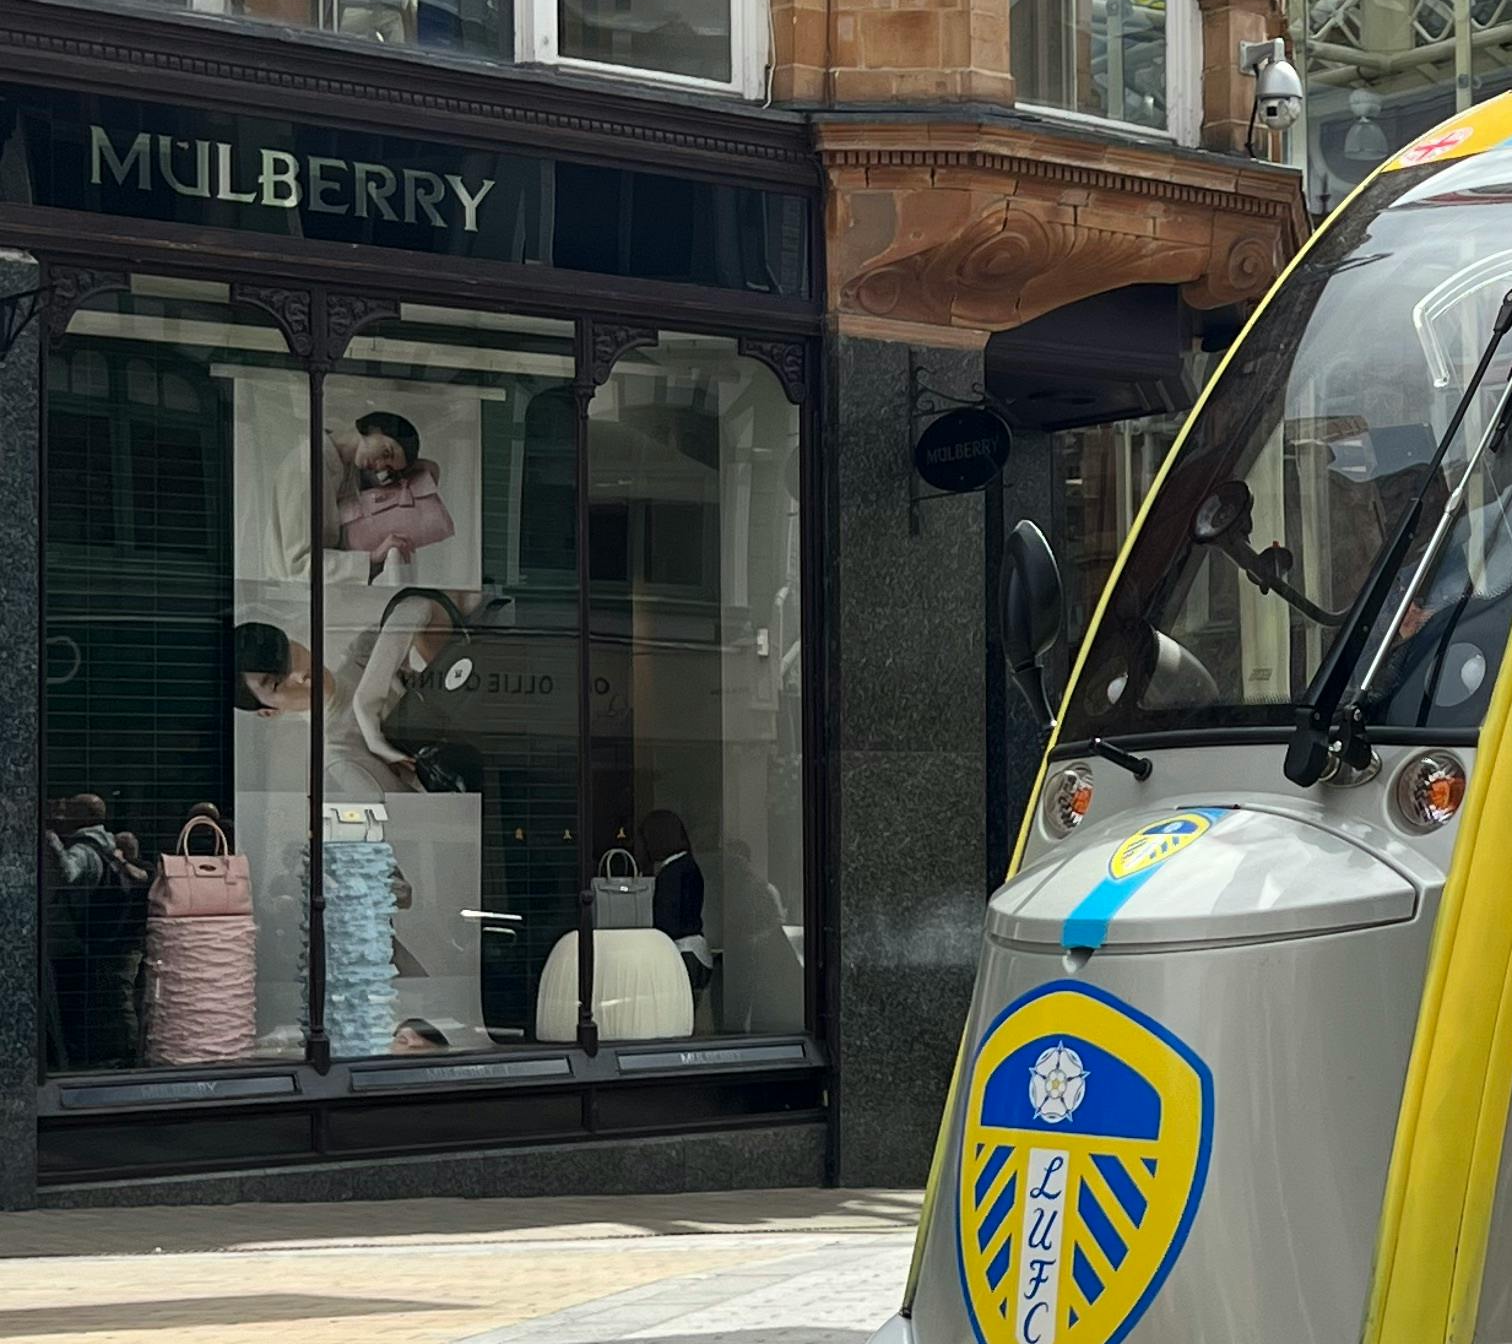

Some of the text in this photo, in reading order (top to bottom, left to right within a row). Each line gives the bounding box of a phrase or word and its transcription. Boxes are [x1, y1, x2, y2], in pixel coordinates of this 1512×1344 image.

[89, 124, 497, 233] MULBERRY
[927, 437, 999, 464] MULBERRY
[1023, 1156, 1063, 1344] LUFC
